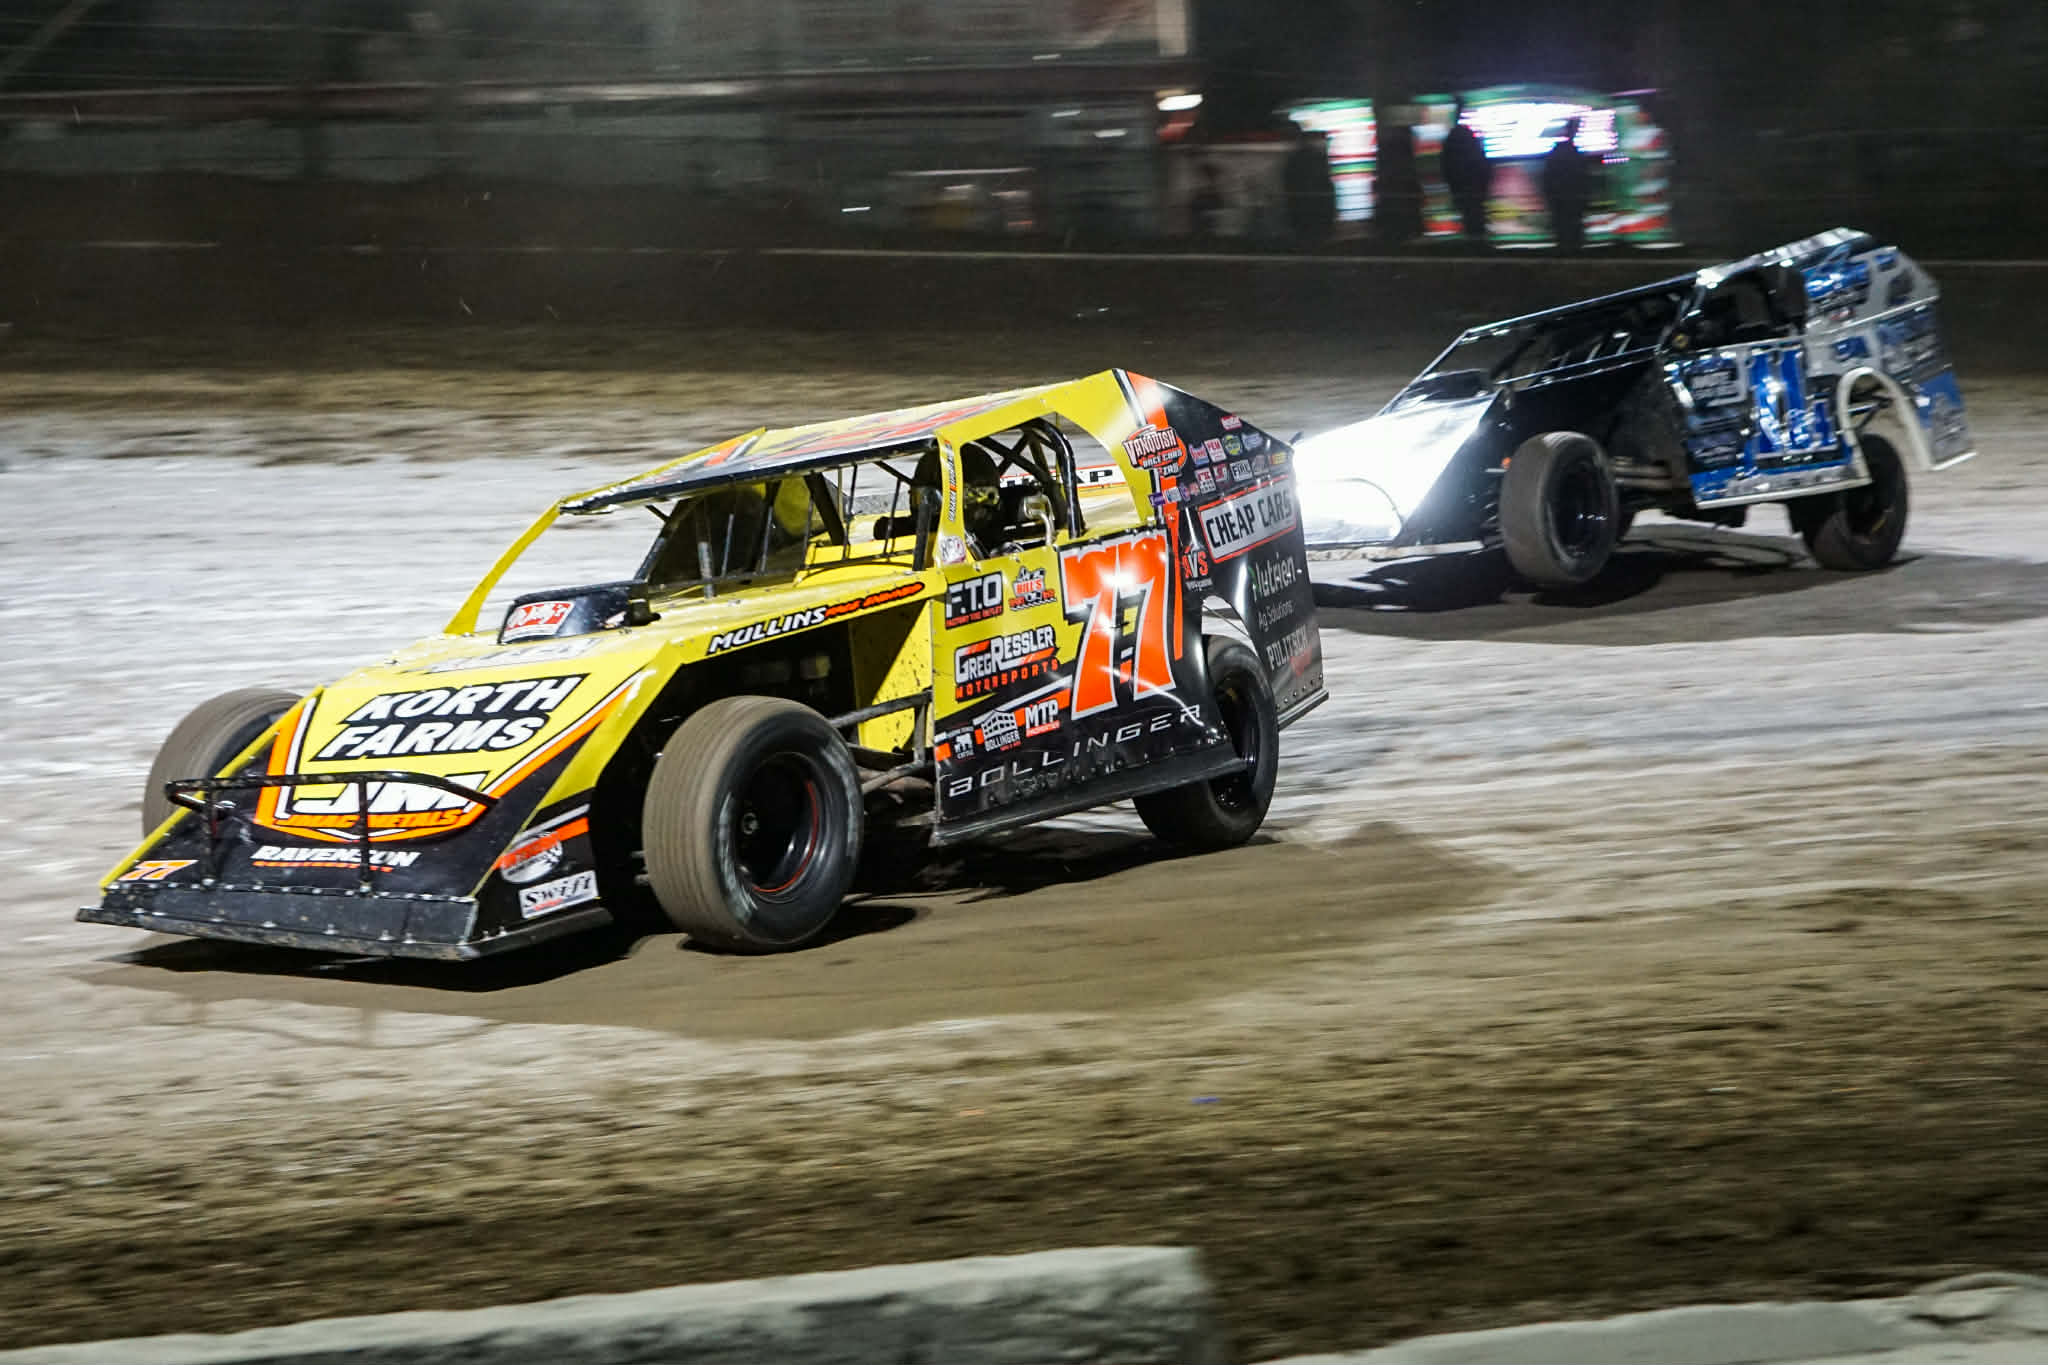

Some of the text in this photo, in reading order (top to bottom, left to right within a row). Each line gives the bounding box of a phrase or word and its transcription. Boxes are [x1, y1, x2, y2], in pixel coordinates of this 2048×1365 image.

[1123, 429, 1177, 466] VANQUISH
[1206, 489, 1293, 549] CHEAP CARS
[1249, 552, 1297, 602] Nutrien
[708, 606, 828, 654] MULLINS
[1059, 528, 1177, 721] 77
[342, 674, 586, 723] KORTH
[955, 658, 1058, 699] MOTORSPORTS
[1025, 698, 1059, 730] MTP
[315, 715, 547, 759] FARMS
[949, 704, 1201, 798] BOLLINGER
[985, 729, 1020, 752] BOLLINGER
[291, 772, 490, 814] JM
[118, 859, 199, 881] 77
[524, 875, 592, 909] Swift
